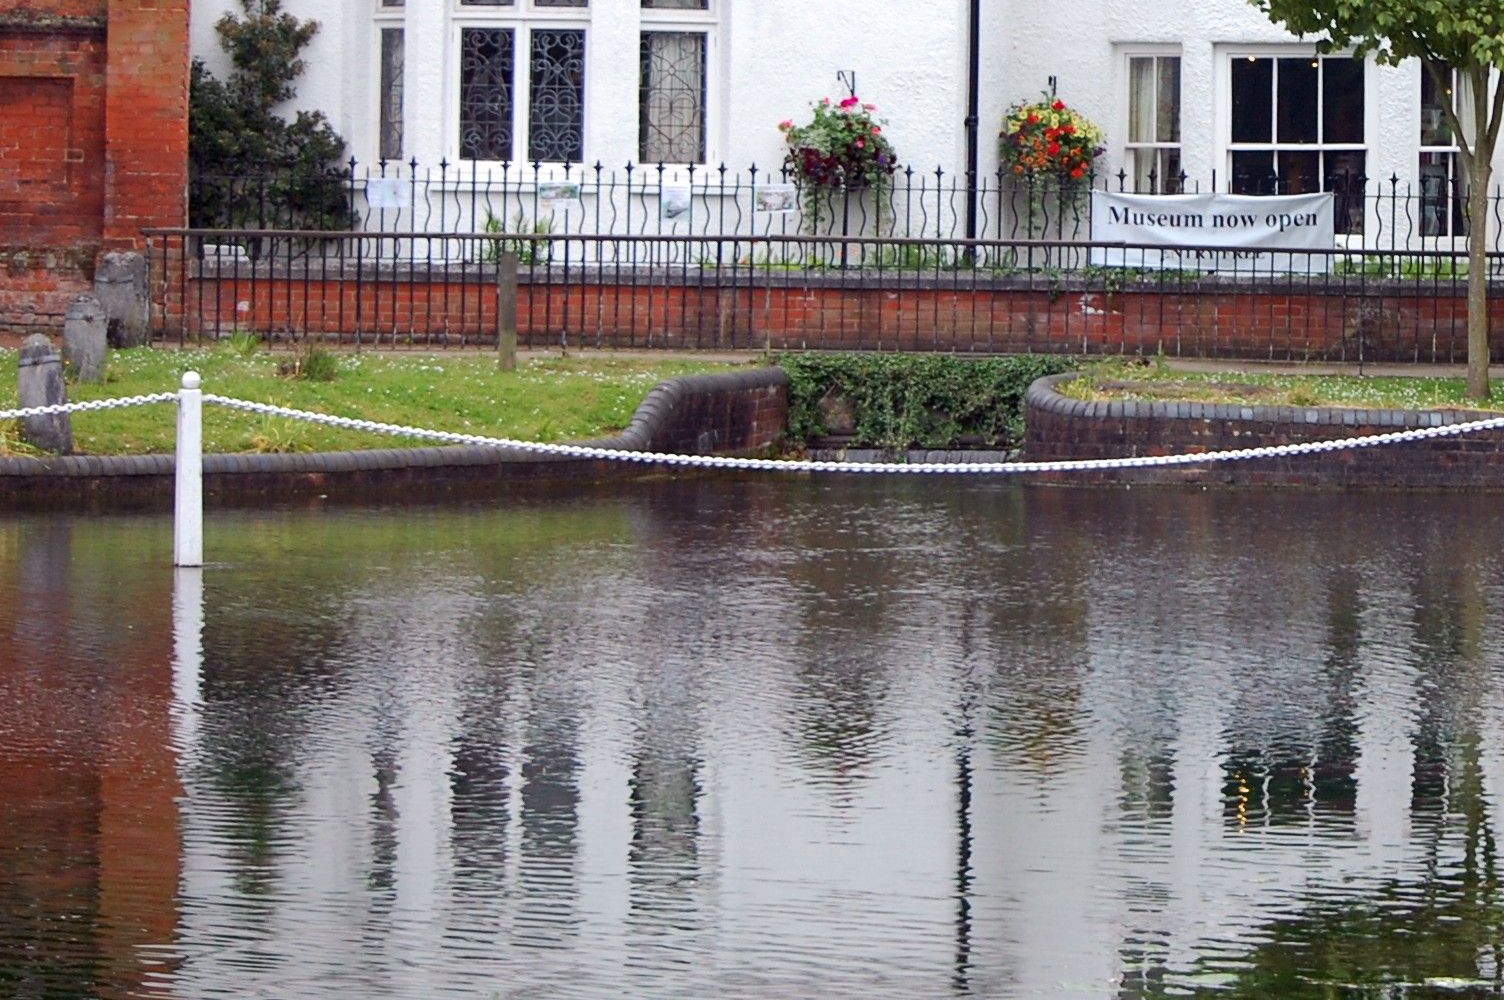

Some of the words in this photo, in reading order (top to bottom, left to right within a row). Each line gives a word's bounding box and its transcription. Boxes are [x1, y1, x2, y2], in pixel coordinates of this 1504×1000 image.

[1108, 206, 1203, 228] Museum
[1212, 211, 1258, 228] now
[1265, 211, 1318, 232] open
